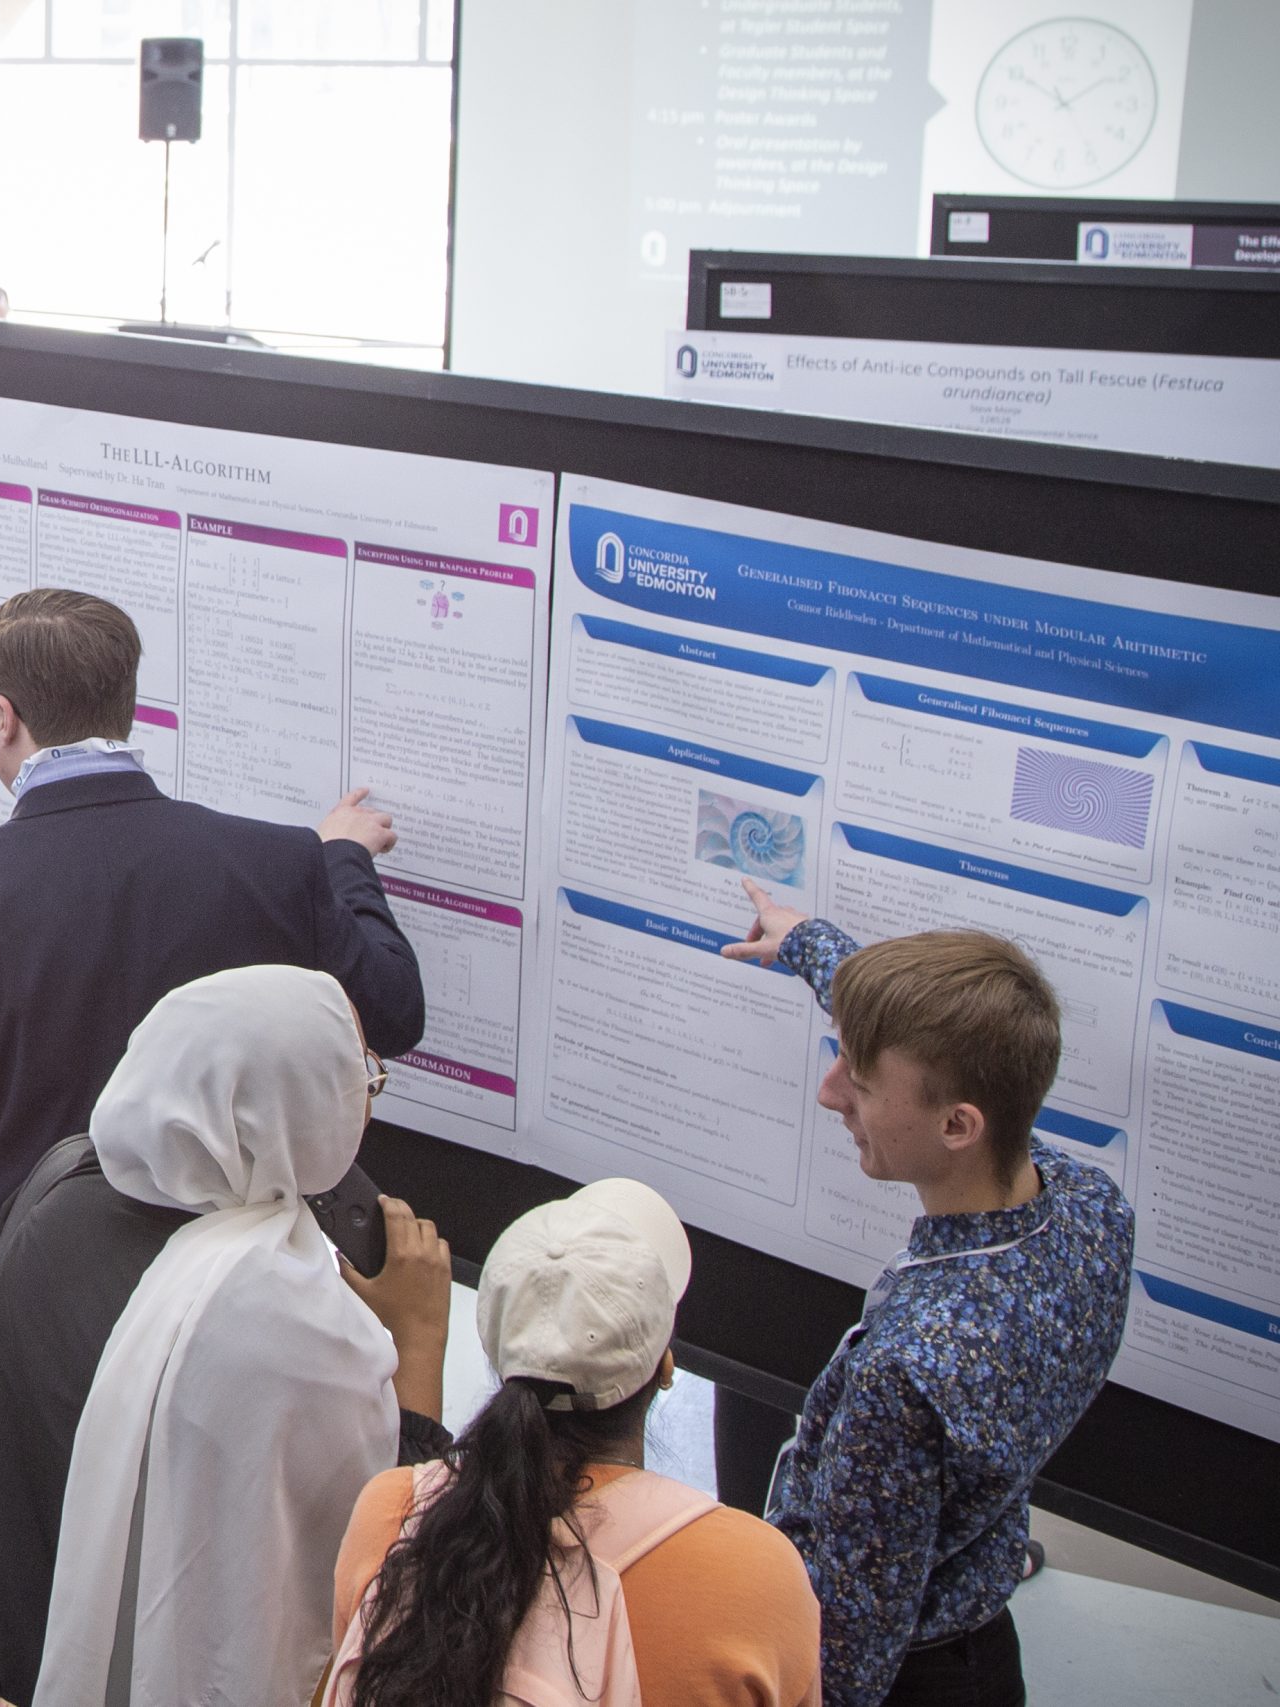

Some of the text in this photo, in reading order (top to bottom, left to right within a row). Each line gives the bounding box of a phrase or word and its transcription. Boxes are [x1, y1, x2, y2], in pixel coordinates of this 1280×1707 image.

[715, 109, 760, 125] Poster
[763, 111, 817, 127] Awards
[701, 361, 767, 371] UNIVERSITY
[709, 370, 774, 381] EDMONTON
[786, 354, 1224, 394] Effects of Anti-ice Compounds on Tall Fescue (Festuca
[58, 463, 103, 481] Supervised
[104, 471, 116, 484] by
[132, 474, 144, 487] Ha
[146, 476, 165, 490] Tran
[190, 518, 233, 536] EXAMPLE
[357, 547, 514, 582] ENCRYPTION USING THE KNAPSACK PROBLEM
[628, 544, 690, 567] CONCORDIA
[628, 558, 709, 585] UNIVERSITY
[636, 571, 717, 600] EDMONTON
[737, 563, 1208, 664] GENERALISED FIBONACCI SEQUENCES UNDER MODULAR ARITHMETIC
[678, 644, 717, 660] Abstract
[787, 599, 1150, 680] Connor Riddlesden Department of Mathematical and Physical Sciences
[918, 692, 1089, 738] Generalised Fibonacci Sequences
[668, 743, 721, 767] Applications
[959, 860, 1009, 882] Theorems
[645, 918, 719, 948] Basic Definitions
[395, 1052, 471, 1081] NFORMATION
